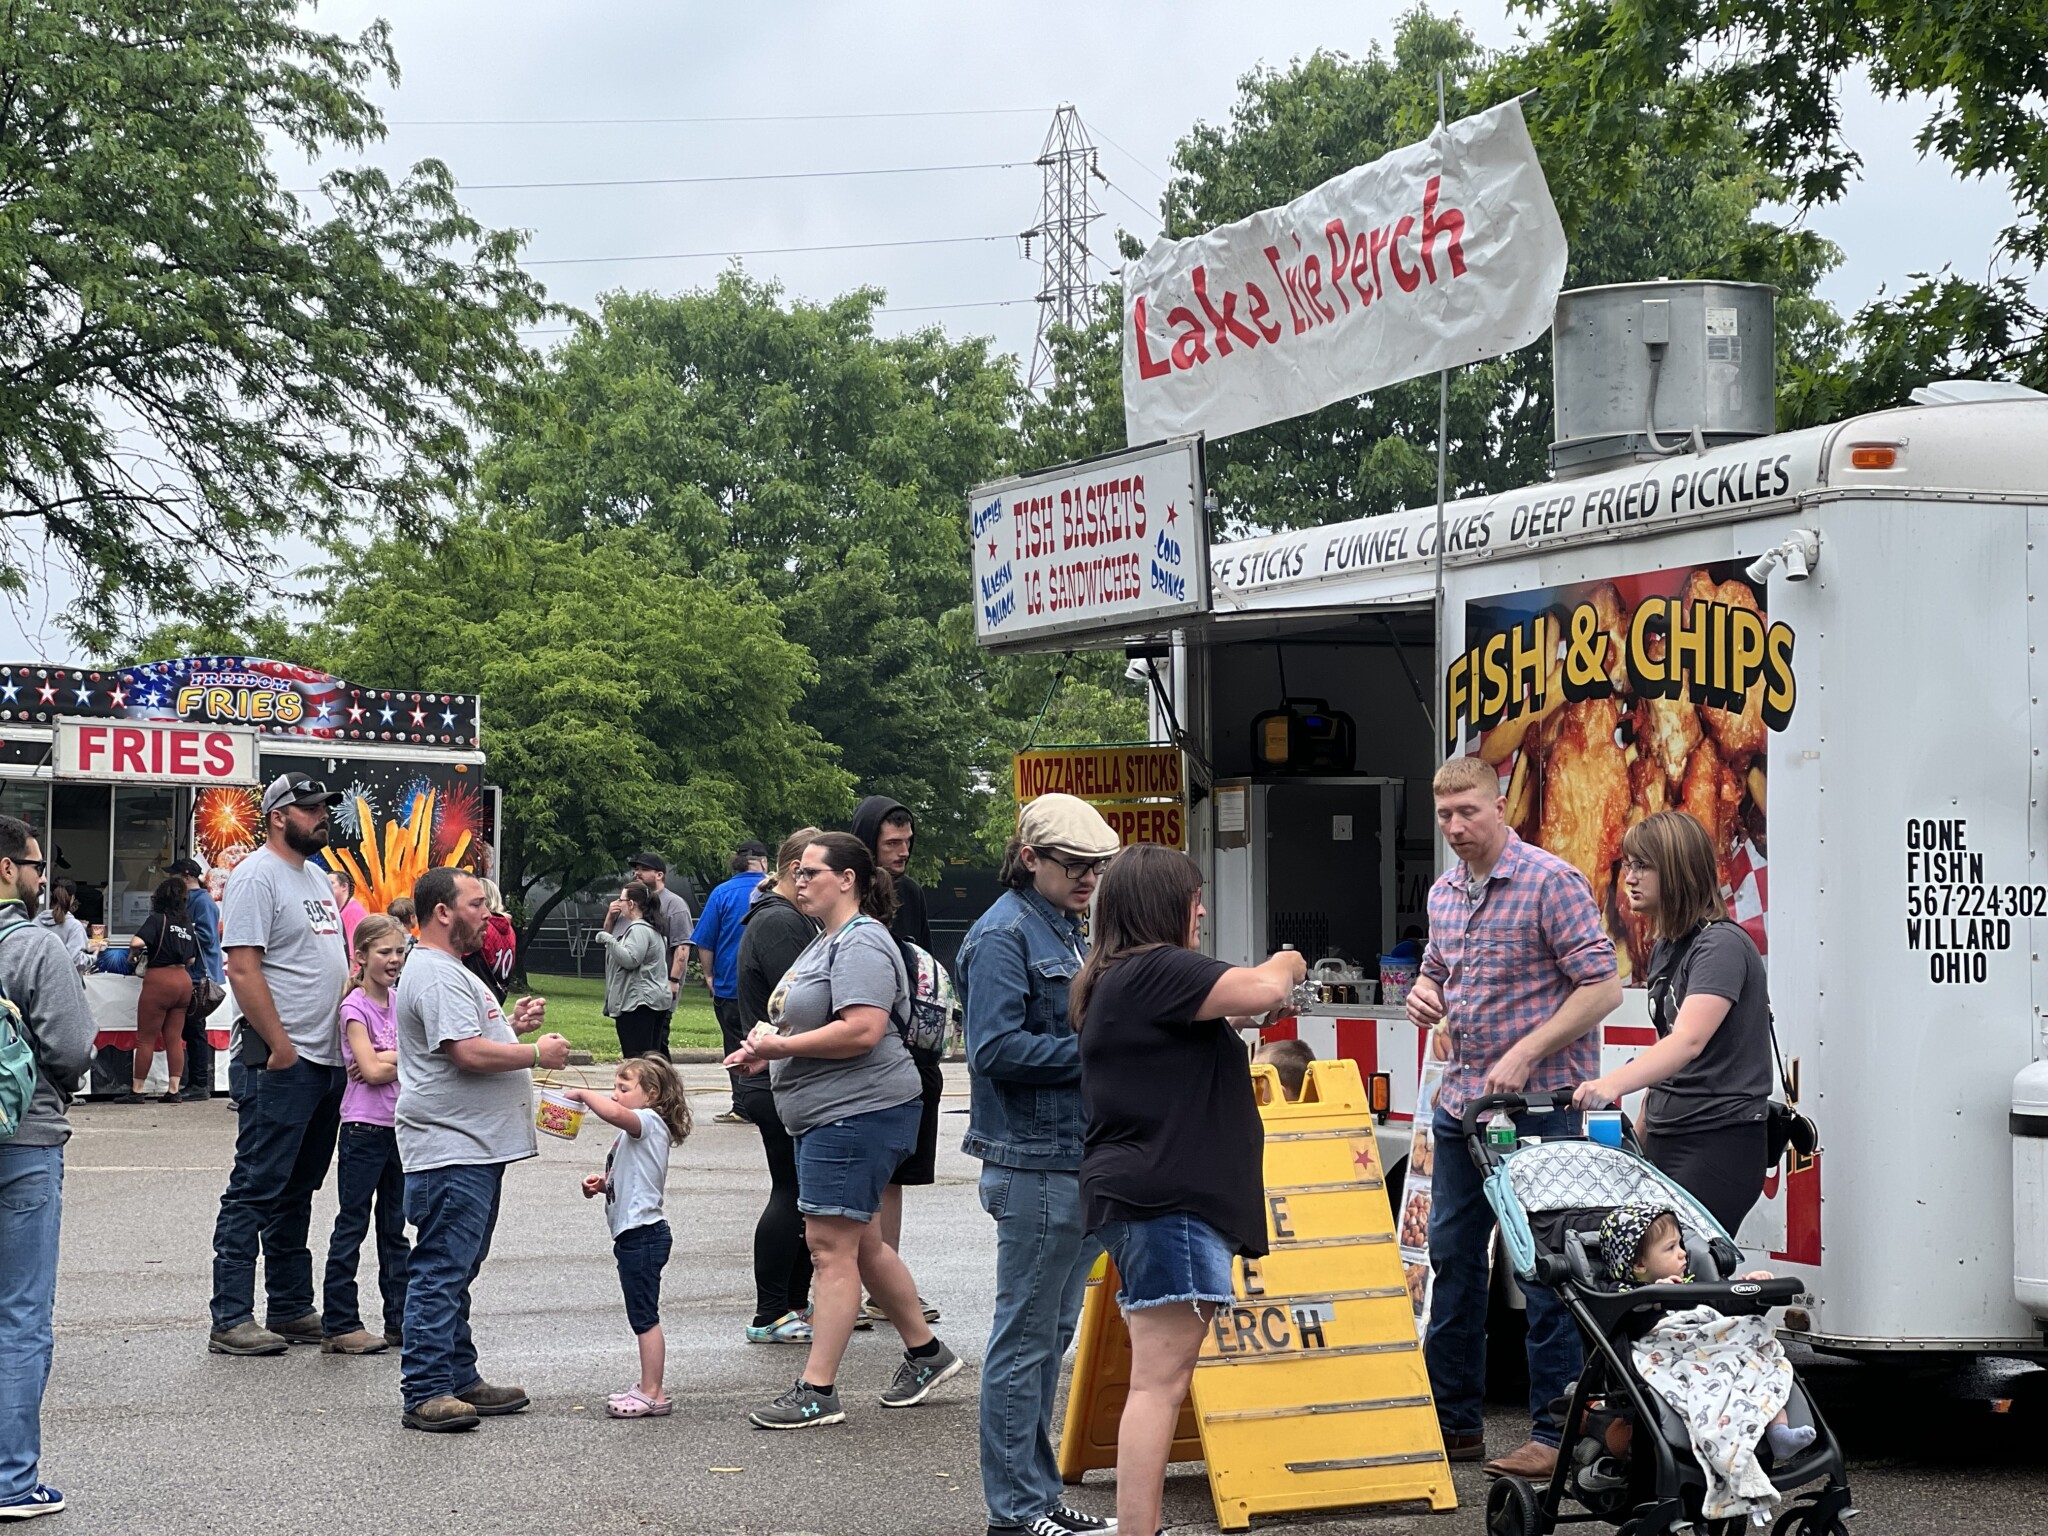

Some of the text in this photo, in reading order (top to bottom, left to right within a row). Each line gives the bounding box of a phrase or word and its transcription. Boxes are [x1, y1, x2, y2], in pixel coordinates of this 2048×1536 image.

[1133, 176, 1467, 380] Lake Erie Perch
[974, 495, 1004, 539] CATFISH
[1013, 474, 1147, 560] FISH BASKETS
[1236, 543, 1308, 586] STICKS
[1324, 526, 1409, 572] FUNNEL
[1416, 511, 1495, 557] CAKES
[1510, 495, 1577, 541] DEEP
[1582, 480, 1660, 528] FRIED
[1672, 454, 1792, 511] PICKLES
[1156, 529, 1181, 566] COLD
[981, 560, 1013, 603] ALASKAN
[1050, 552, 1142, 612] SANDWICHES
[1151, 560, 1185, 602] DRINKS
[984, 588, 1016, 632] POLLOCK
[190, 672, 292, 692] FREEDOM
[1448, 597, 1796, 747] FISH & CHIPS
[177, 686, 303, 723] FRIES
[79, 727, 235, 776] FRIES
[1020, 753, 1178, 797] MOZZARELLA STICKS
[1104, 809, 1181, 846] PPERS
[1907, 819, 1967, 850] GONE
[1907, 852, 1984, 884] FISH'N
[1908, 885, 2048, 917] 567-224-302
[1907, 919, 2011, 950] WILLARD
[493, 948, 513, 979] 10
[1931, 952, 1987, 984] OHIO
[1734, 1284, 1760, 1294] GRACO
[1213, 1306, 1326, 1353] ERCH
